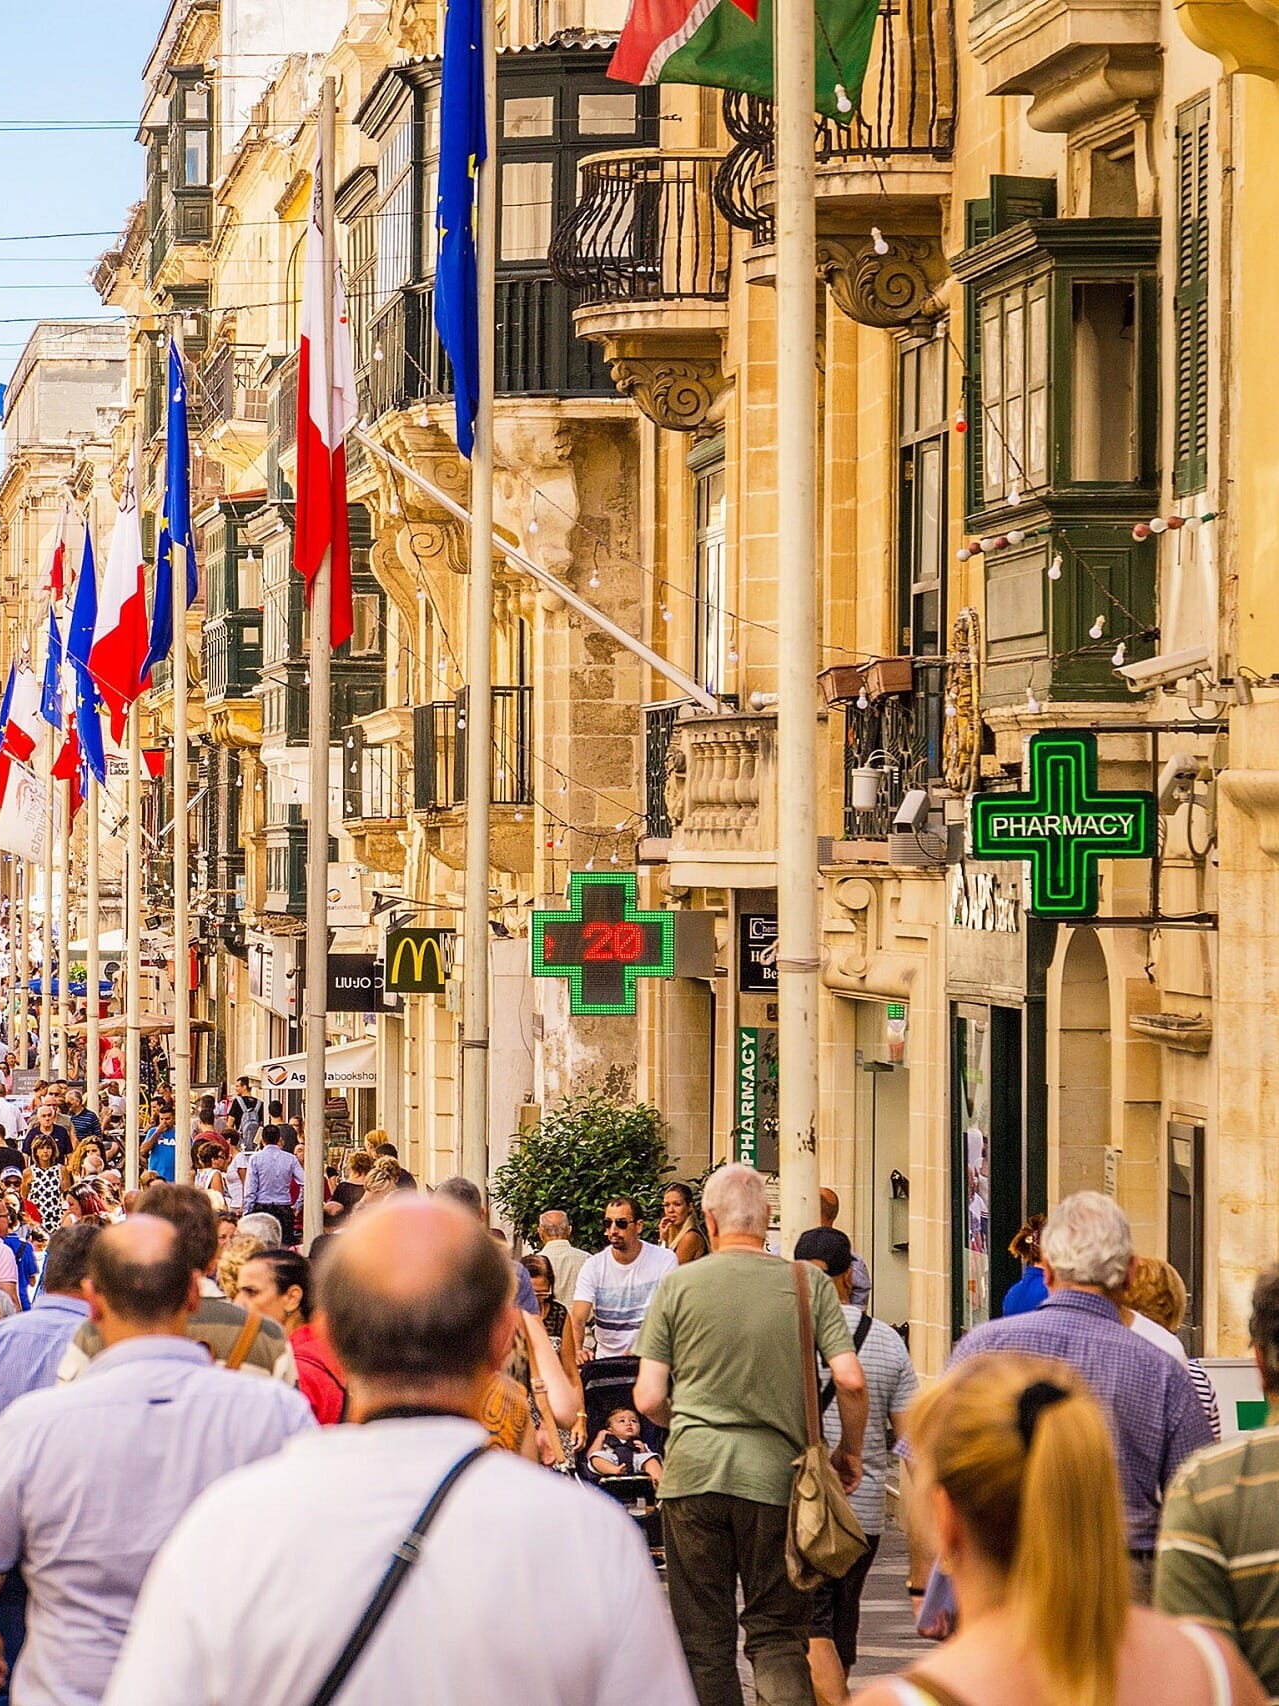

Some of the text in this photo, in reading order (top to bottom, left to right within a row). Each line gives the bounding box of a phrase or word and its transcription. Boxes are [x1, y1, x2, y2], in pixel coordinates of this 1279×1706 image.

[992, 814, 1134, 837] PHARMACY
[583, 921, 643, 961] 20
[740, 1032, 756, 1167] PHARMACY
